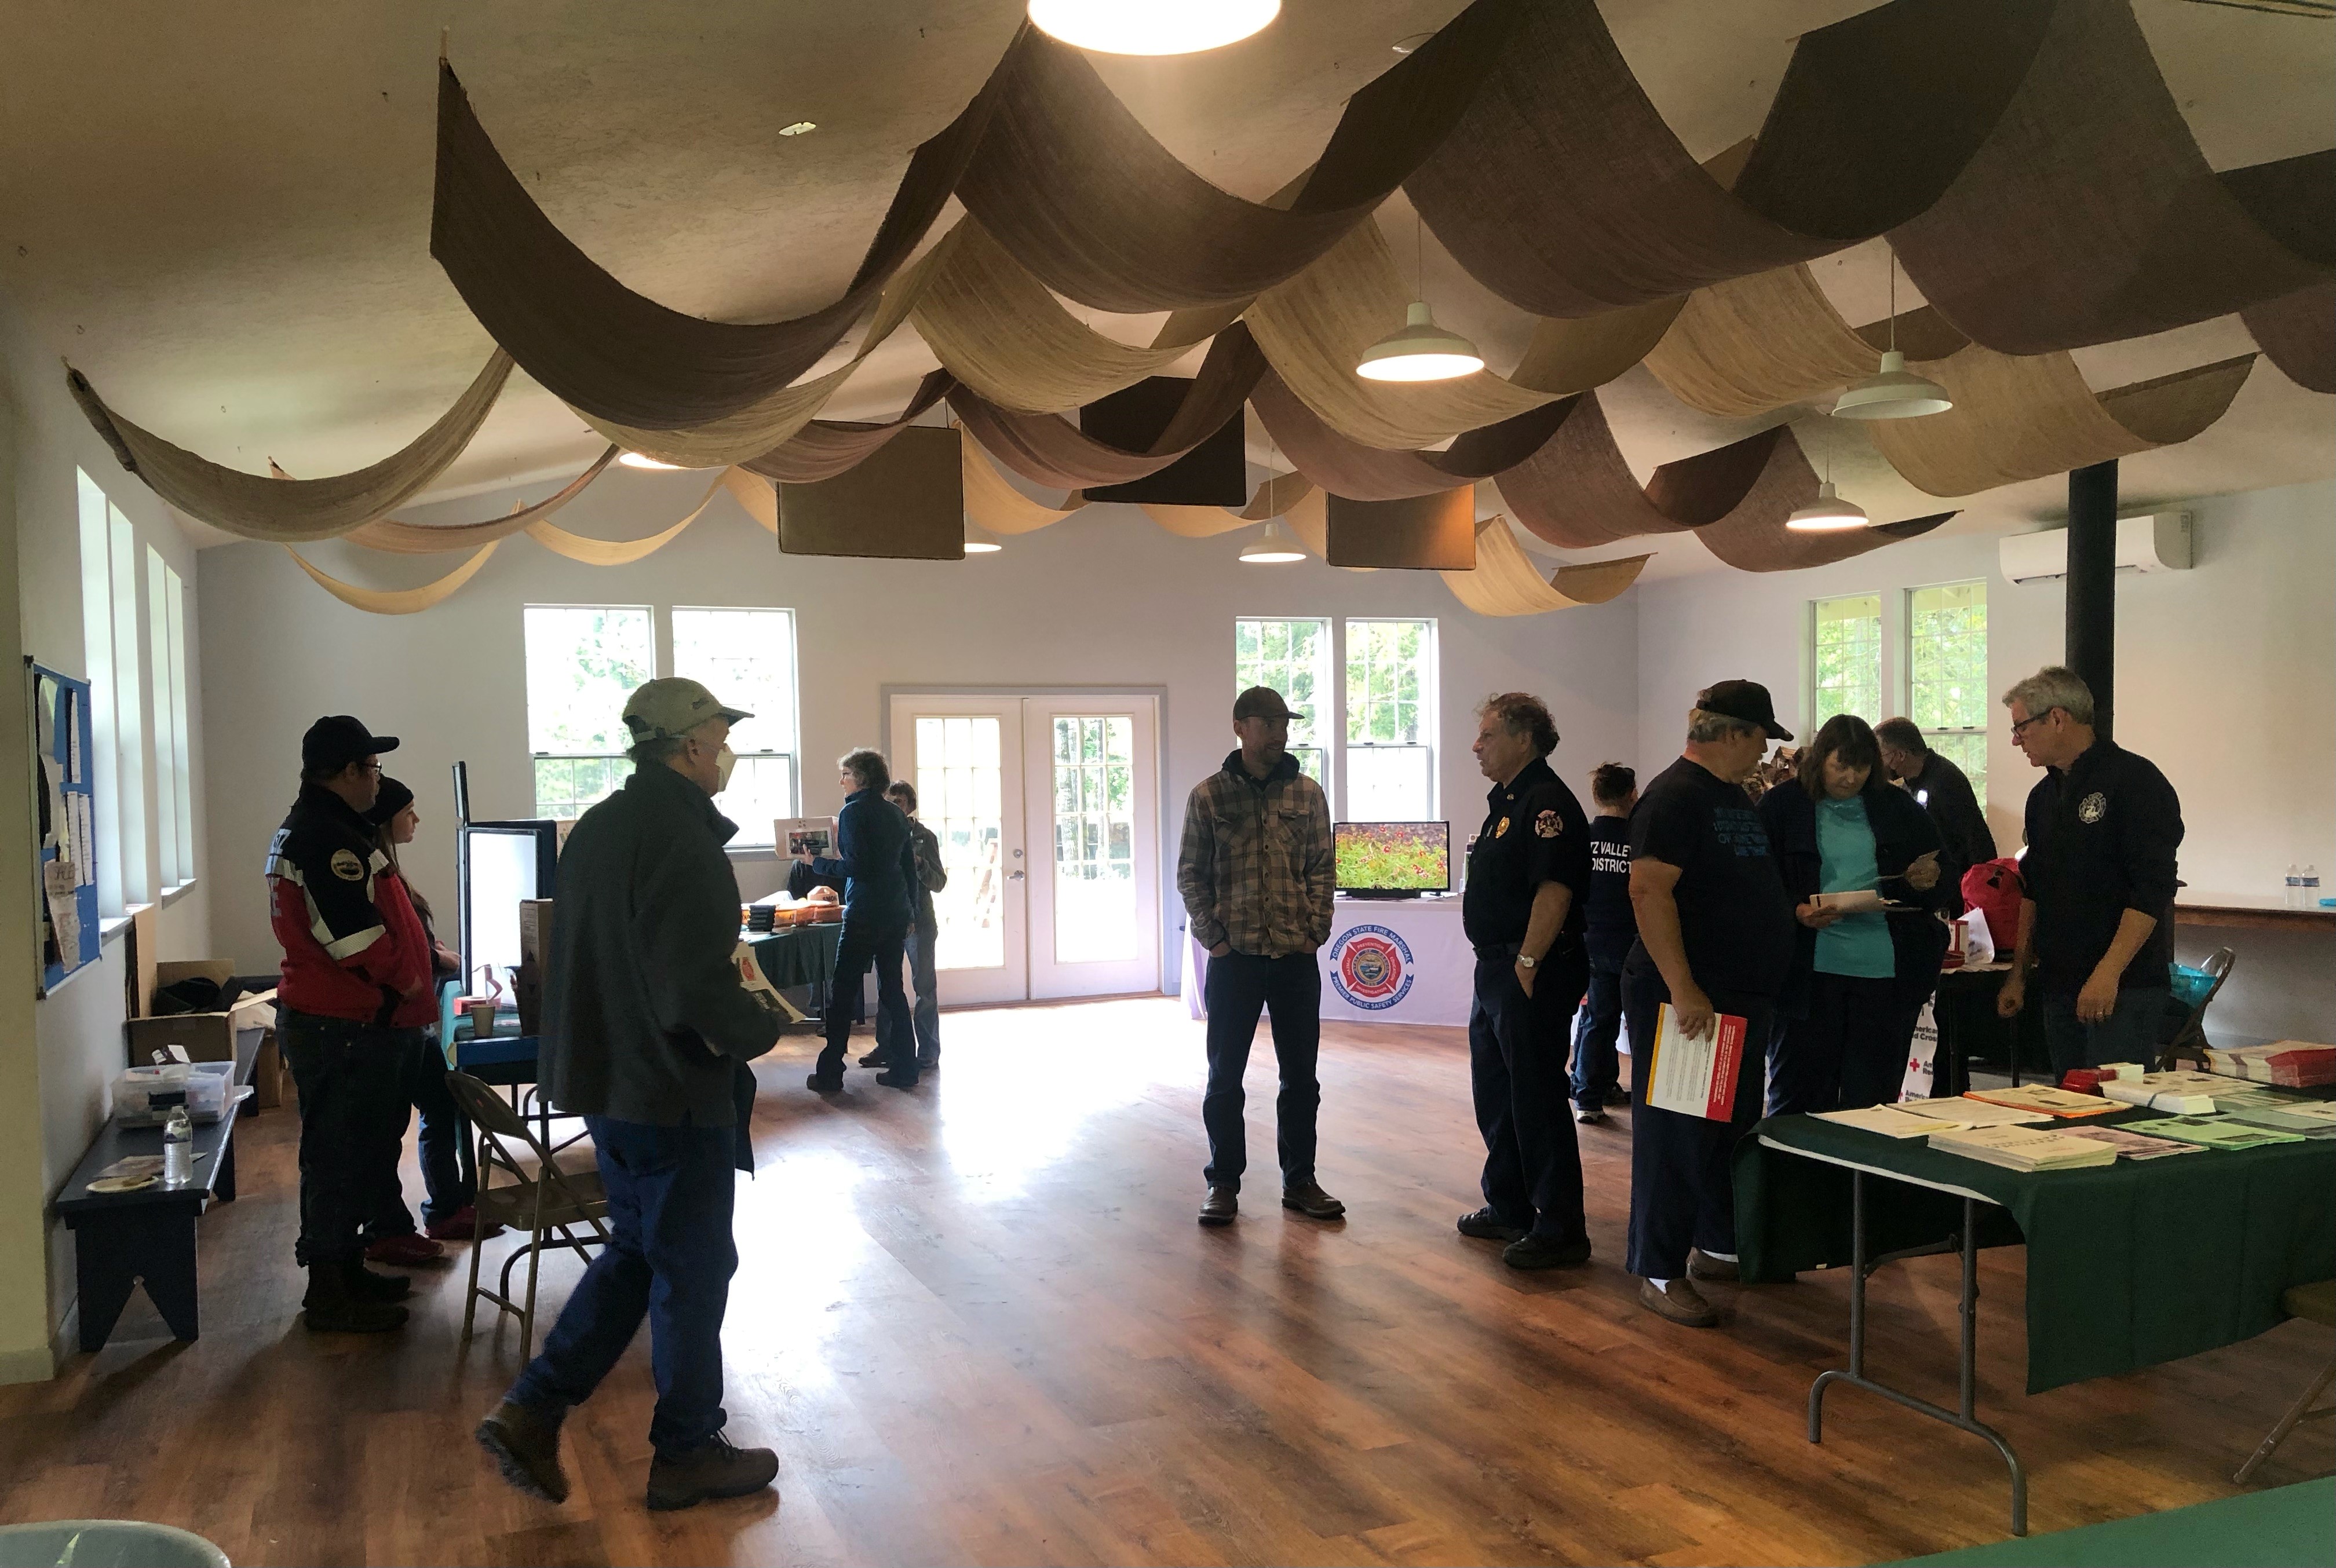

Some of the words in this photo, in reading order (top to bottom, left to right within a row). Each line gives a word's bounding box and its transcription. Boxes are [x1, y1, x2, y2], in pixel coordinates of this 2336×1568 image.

[1332, 933, 1352, 957] OREGON
[1353, 926, 1372, 935] STATE
[1374, 927, 1389, 935] FIRE
[1389, 933, 1411, 962] MARSHAL
[1333, 977, 1351, 999] PREMIER
[1350, 997, 1370, 1008] PUBLIC
[1371, 1000, 1392, 1009] SAFETY
[1393, 980, 1411, 1002] SERVICES
[1356, 985, 1387, 994] INVESTIGATION
[1920, 1033, 1938, 1041] Cros
